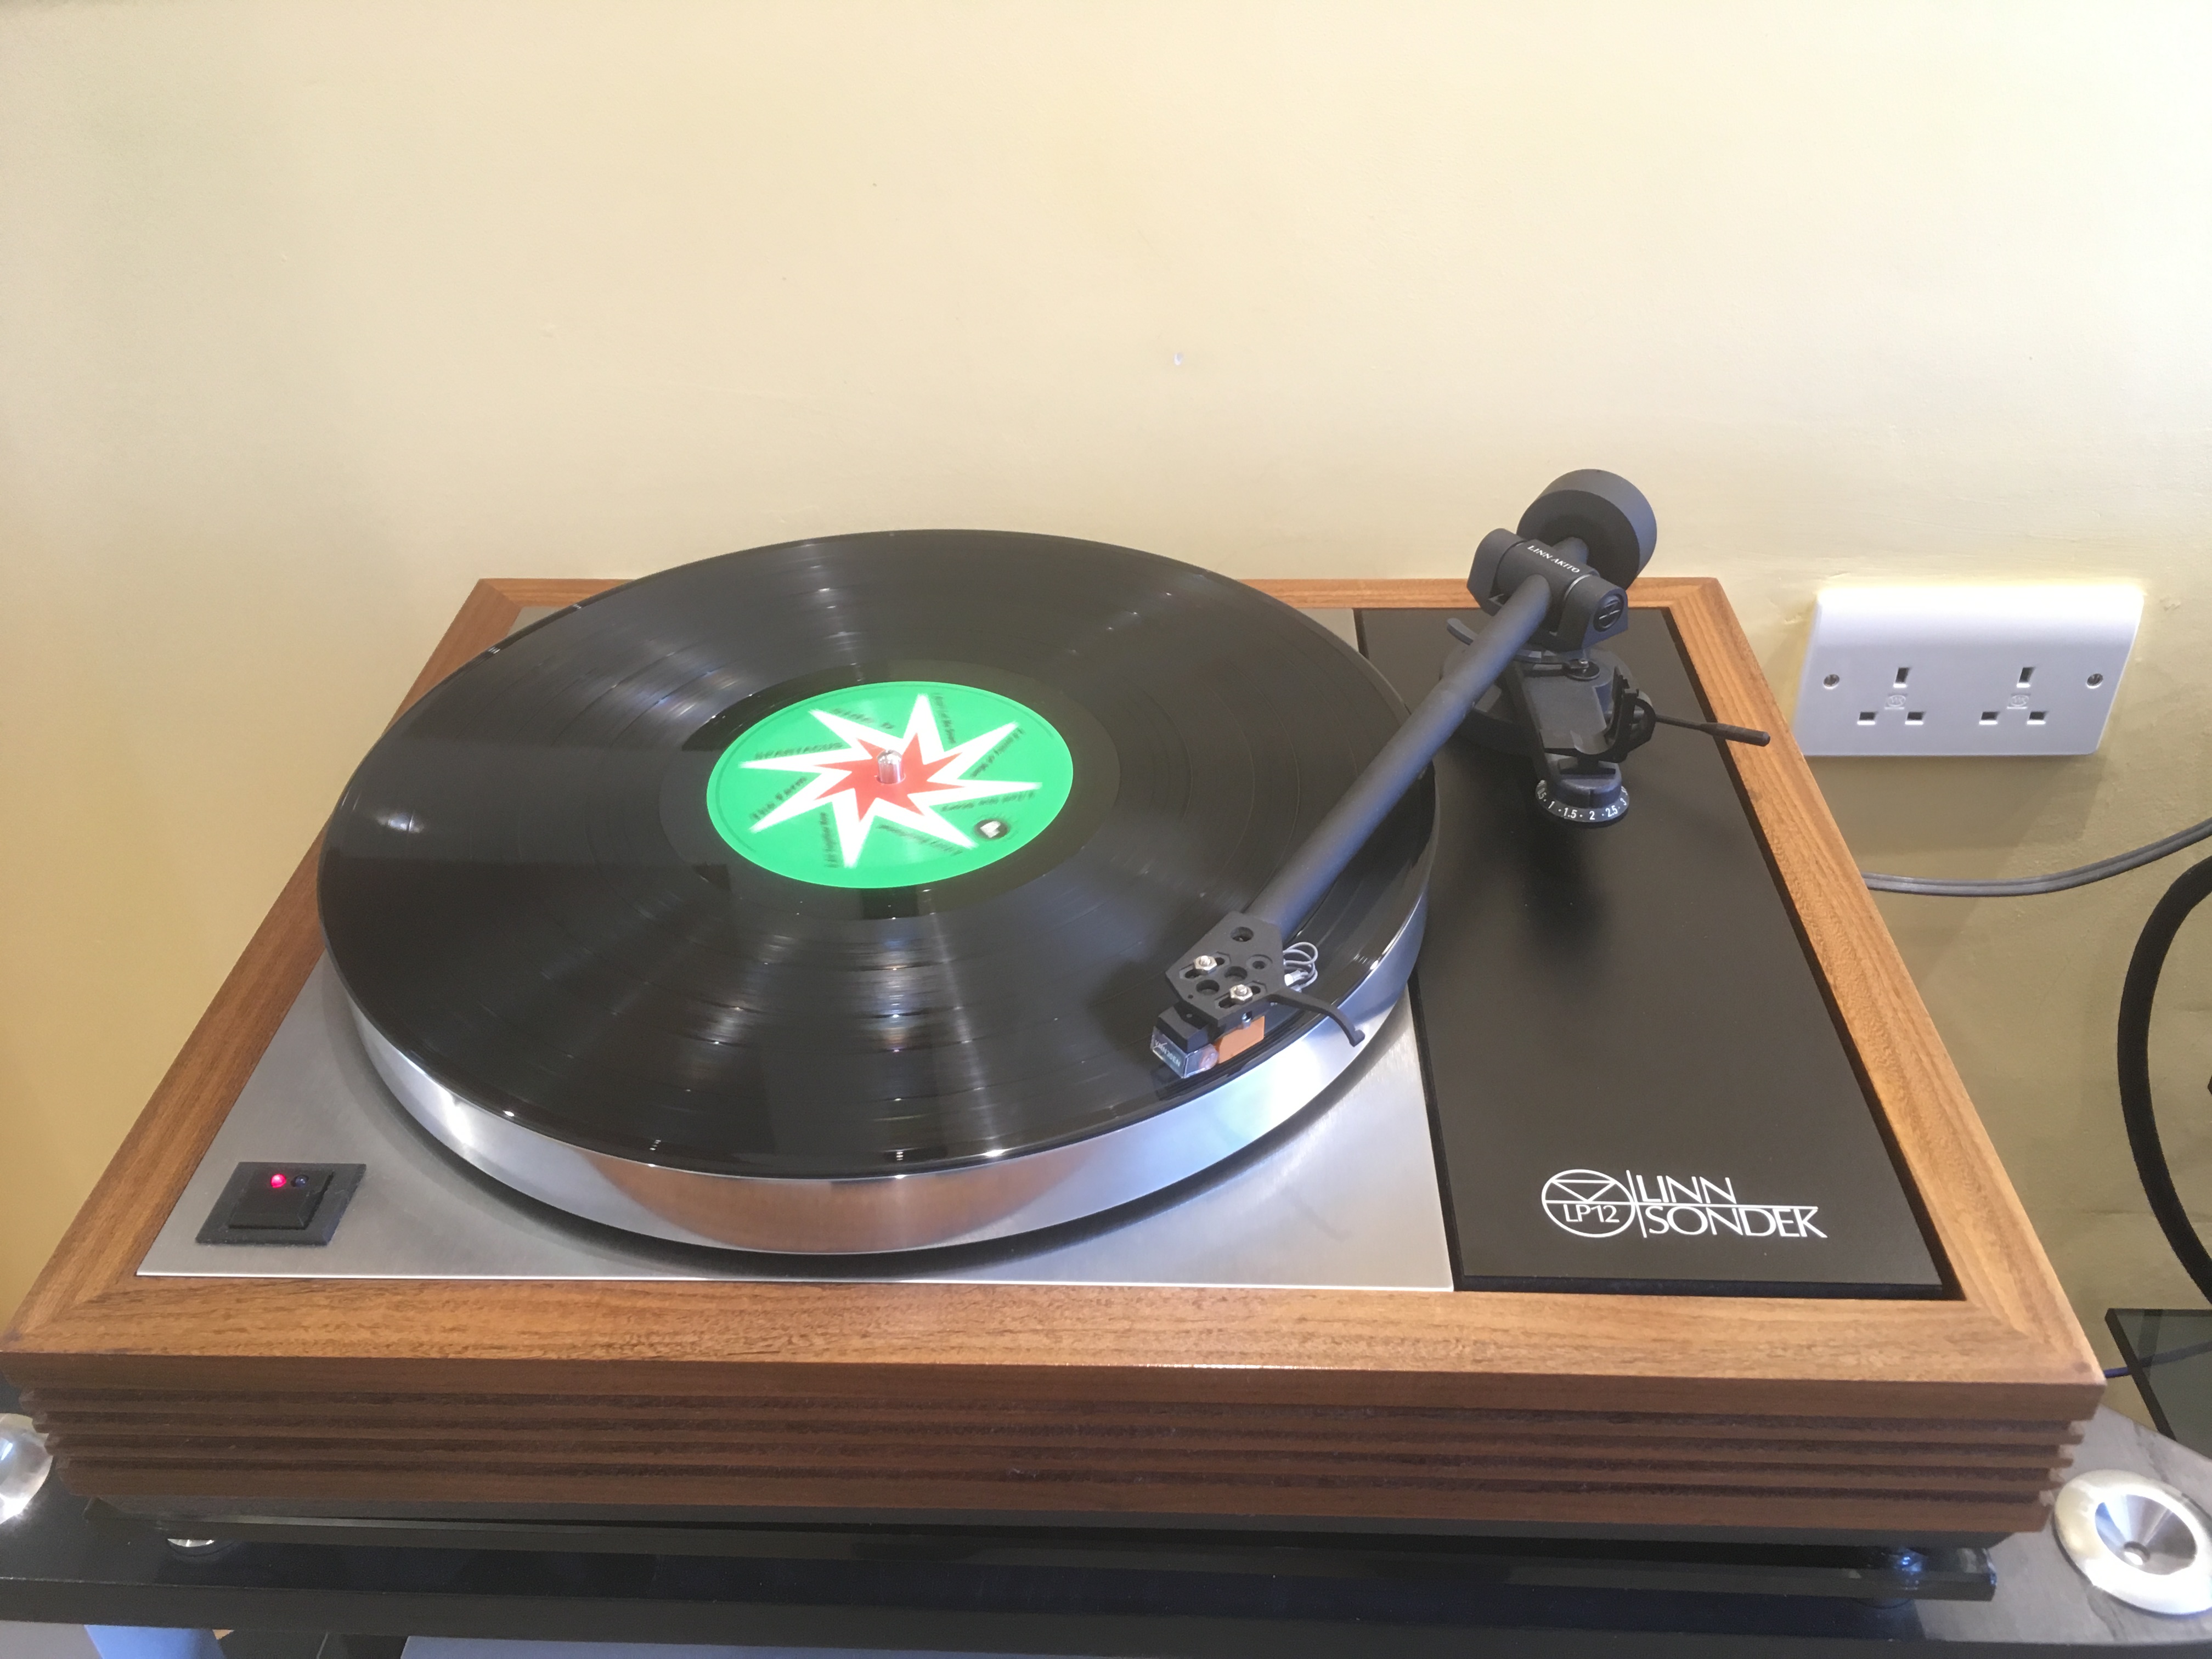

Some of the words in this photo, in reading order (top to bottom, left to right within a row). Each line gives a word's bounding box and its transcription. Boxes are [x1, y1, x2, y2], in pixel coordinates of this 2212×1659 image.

[1527, 545, 1553, 559] LINN
[1550, 558, 1580, 573] AKITO
[1548, 801, 1555, 809] 1
[1564, 808, 1577, 819] 1.5
[1589, 811, 1595, 820] 2
[1605, 805, 1618, 817] 2.5
[1620, 797, 1627, 806] 3
[1636, 1175, 1736, 1204] LINN
[1563, 1204, 1620, 1223] LP12
[1645, 1206, 1828, 1238] SONDEK
